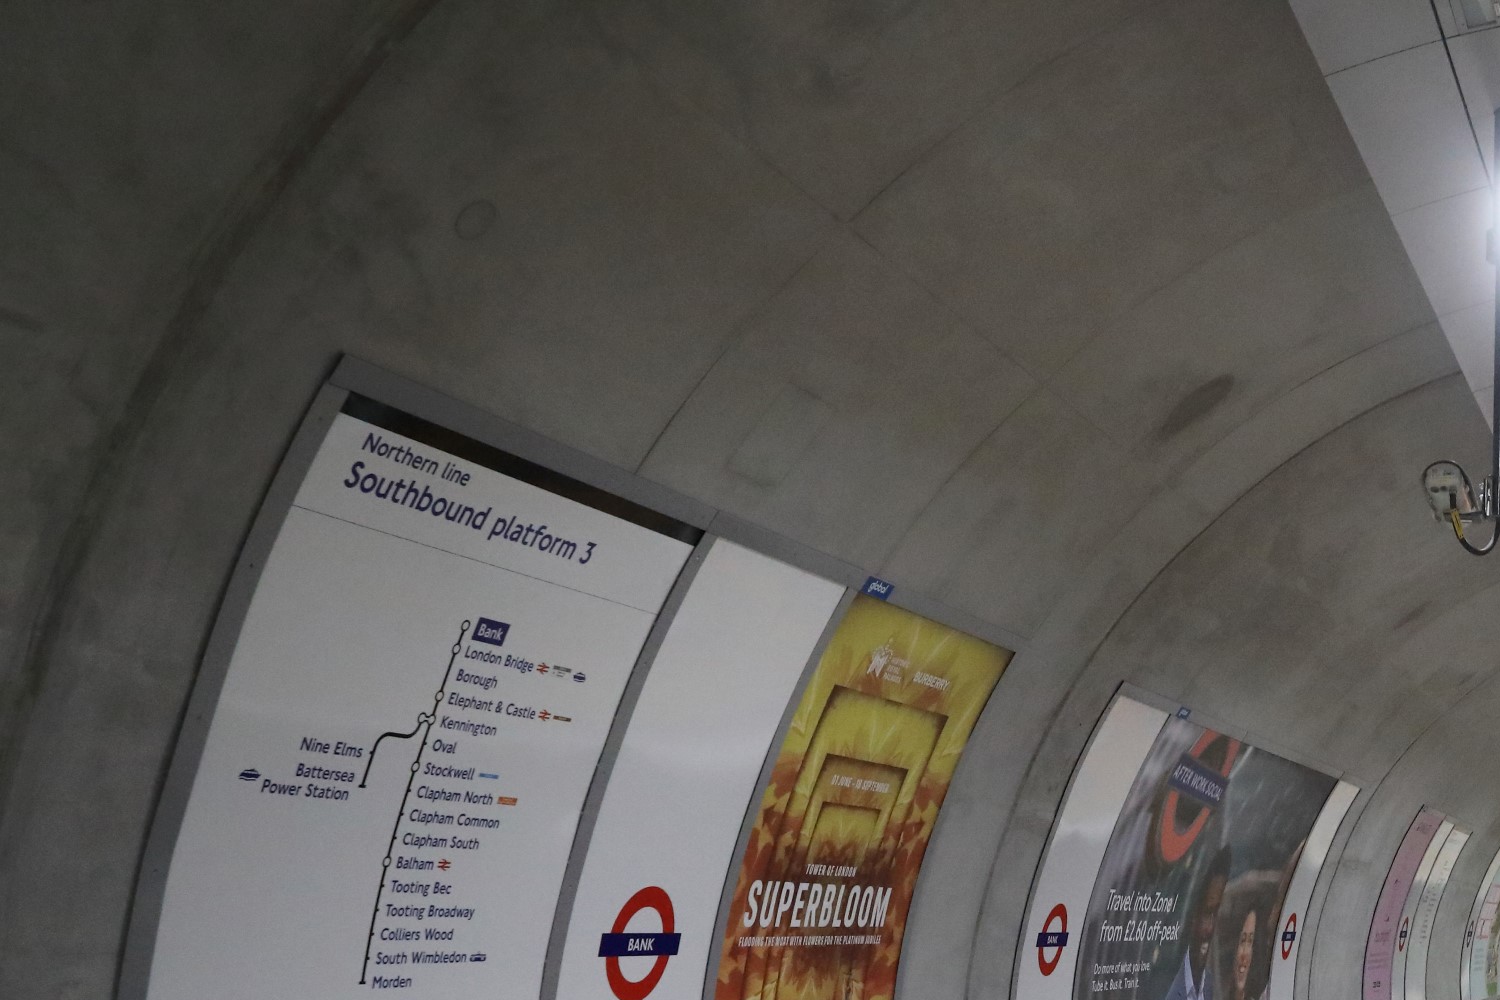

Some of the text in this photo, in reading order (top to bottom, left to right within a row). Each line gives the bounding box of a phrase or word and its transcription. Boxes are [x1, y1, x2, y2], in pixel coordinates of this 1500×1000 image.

[361, 432, 471, 487] Northern line
[344, 461, 597, 564] Southbound platform 3
[477, 624, 504, 642] Bank
[465, 646, 534, 674] London Bridge
[456, 669, 498, 689] Borough
[448, 692, 536, 721] Elephant & Castle
[440, 716, 497, 736] Kennington
[300, 737, 363, 759] Nine Elms
[432, 739, 456, 754] Oval
[295, 763, 355, 782] Battersea
[423, 762, 475, 781] Stockwell
[1173, 764, 1194, 785] AFTER
[261, 779, 349, 801] Power Station
[417, 785, 493, 805] Clapham North
[409, 809, 500, 829] Clapham Common
[402, 832, 480, 851] Clapham South
[396, 856, 434, 871] Balham
[806, 864, 858, 877] TOWER OF LONDON
[391, 880, 452, 897] Tooting Bec
[743, 879, 892, 928] SUPERBLOOM
[1107, 888, 1179, 912] Travel into Zone 1
[386, 903, 475, 921] Tooting Broadway
[380, 927, 454, 941] Colliers Wood
[738, 936, 764, 947] FLOODING
[764, 937, 775, 946] THE
[1099, 920, 1180, 946] from £2.60 off-peak
[628, 938, 656, 951] BANK
[376, 950, 467, 965] South Wimbledon
[1094, 963, 1101, 974] Do
[1101, 965, 1114, 974] more
[372, 975, 412, 989] Morden
